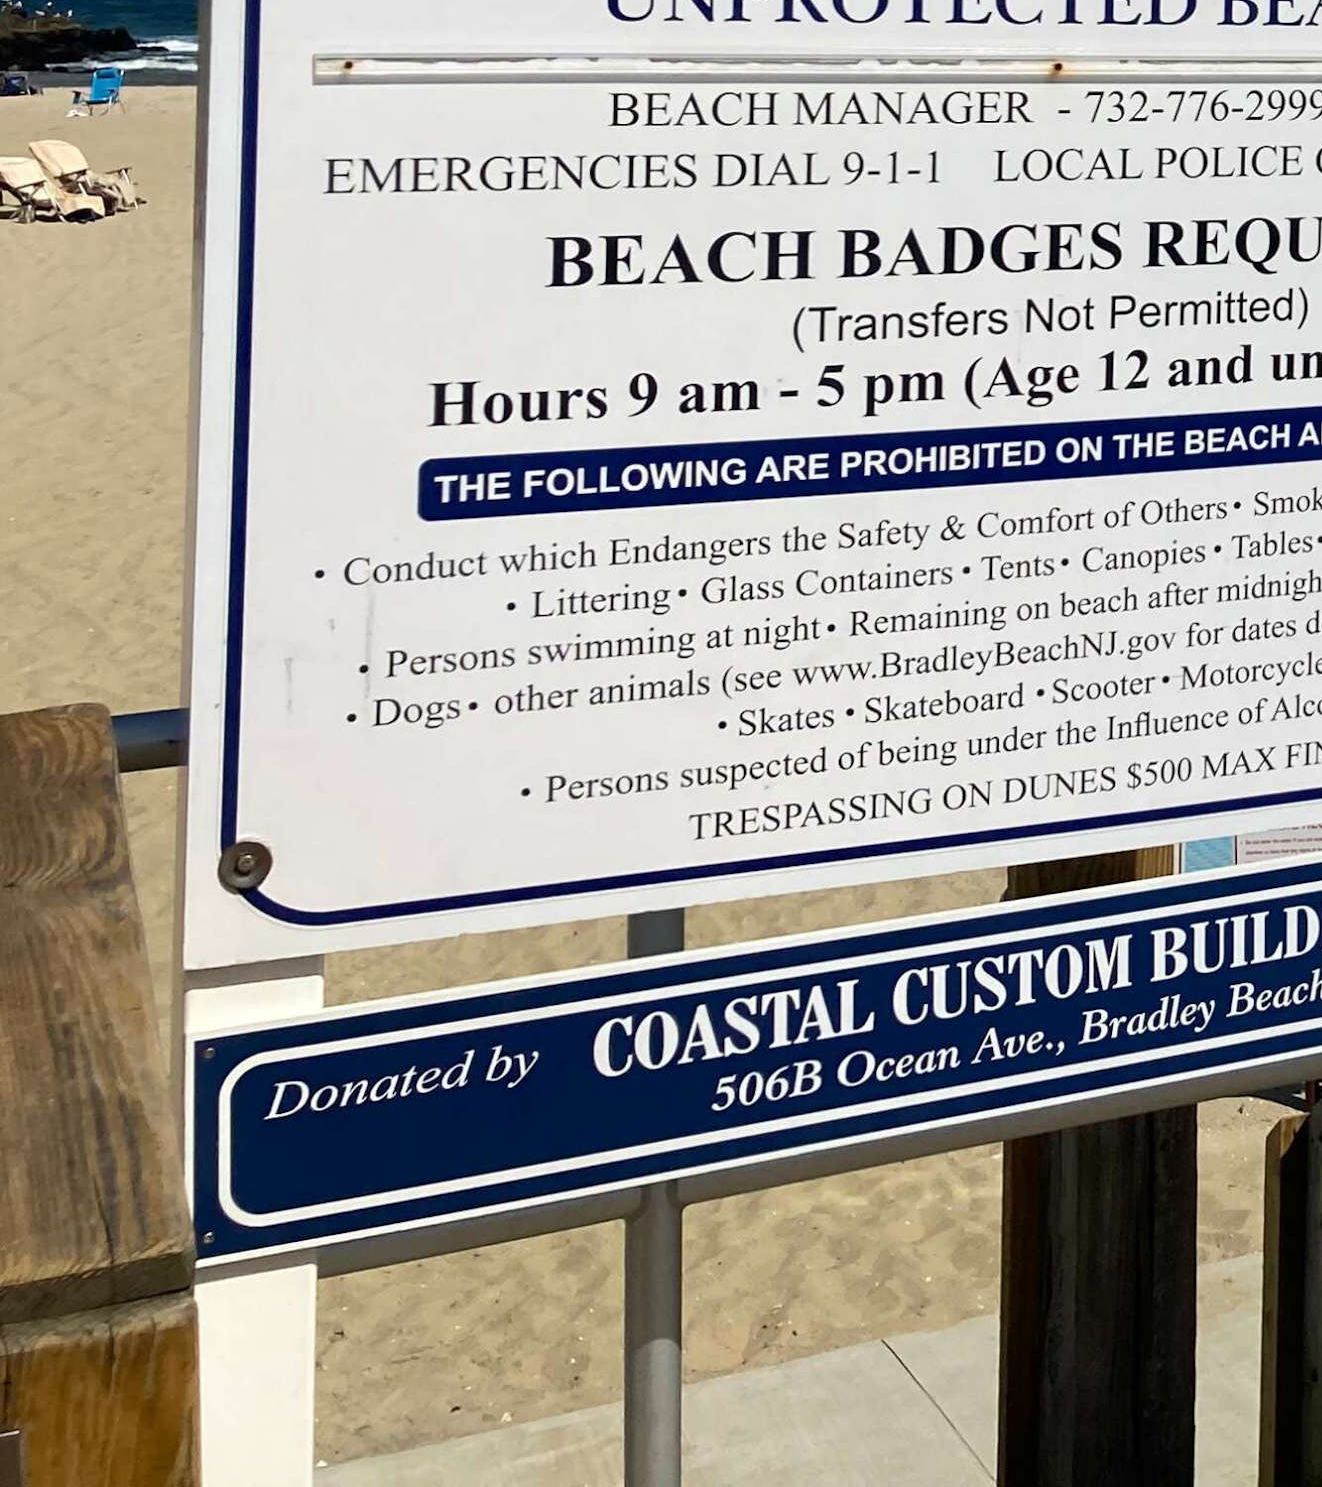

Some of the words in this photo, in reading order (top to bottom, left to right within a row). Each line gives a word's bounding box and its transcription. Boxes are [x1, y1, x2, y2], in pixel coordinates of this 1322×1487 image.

[607, 91, 780, 127] BEACH
[792, 90, 1035, 126] MANAGER
[322, 153, 698, 195] EMERGENCIES
[712, 152, 831, 188] DIAL
[842, 150, 941, 186] 9-1-1
[993, 147, 1144, 183] LOCAL
[1154, 145, 1304, 179] POLICE
[544, 230, 817, 288] BEACH
[837, 221, 1123, 279] BADGES
[792, 301, 1009, 354] (Transfers
[1025, 297, 1095, 334] Not
[1109, 286, 1309, 330] Permitted)
[427, 380, 608, 428] Hours
[628, 372, 659, 418] 9
[678, 380, 761, 414] am
[816, 364, 845, 408] 5
[863, 371, 945, 418] pm
[964, 356, 1080, 410] (Age
[1099, 349, 1150, 392] 12
[1167, 343, 1253, 388] and
[433, 471, 512, 504] THE
[523, 457, 747, 498] FOLLOWING
[755, 452, 830, 484] ARE
[840, 440, 1046, 478] PROHIBITED
[1055, 435, 1103, 464] ON
[1112, 431, 1175, 460] THE
[1184, 423, 1291, 455] BEACH
[343, 551, 488, 586] Conduct
[498, 540, 598, 574] which
[608, 534, 772, 567] Endangers
[782, 525, 827, 553] the
[837, 519, 931, 551] Safety
[939, 514, 966, 542] &
[976, 506, 1095, 539] Comfort
[1103, 500, 1136, 529] of
[1140, 497, 1228, 526] Others
[531, 582, 671, 619] Littering
[701, 575, 785, 604] Glass
[795, 562, 953, 597] Containers
[980, 554, 1056, 582] Tents
[1082, 539, 1206, 575] Canopies
[1230, 530, 1314, 560] Tables
[385, 647, 516, 679] Persons
[527, 626, 697, 666] swimming
[706, 624, 734, 650] at
[743, 614, 821, 651] night
[849, 602, 1008, 637] Remaining
[1016, 601, 1051, 622] on
[1059, 586, 1139, 618] beach
[1147, 581, 1209, 610] after
[371, 698, 461, 730] Dogs
[494, 683, 580, 715] other
[588, 668, 711, 706] animals
[721, 665, 782, 700] (see
[791, 630, 1177, 686] www.BradleyBeachNJ.gov
[1185, 621, 1225, 648] for
[1231, 616, 1297, 643] dates
[738, 707, 835, 737] Skates
[864, 681, 1025, 724] Skateboard
[1052, 675, 1157, 704] Scooter
[545, 770, 669, 804] Persons
[679, 745, 828, 791] suspected
[837, 740, 873, 771] of
[876, 735, 958, 767] being
[967, 725, 1048, 757] under
[1055, 719, 1097, 747] the
[1106, 710, 1229, 742] Influence
[1238, 698, 1268, 725] of
[688, 787, 932, 841] TRESPASSING
[942, 780, 993, 811] ON
[1003, 765, 1116, 804] DUNES
[1127, 757, 1193, 790] $500
[1202, 745, 1277, 780] MAX
[593, 979, 875, 1077] COASTAL
[892, 933, 1133, 1026] CUSTOM
[263, 1049, 476, 1120] Donated
[485, 1044, 539, 1089] by
[711, 1059, 822, 1112] 506B
[837, 1046, 961, 1087] Ocean
[970, 1027, 1065, 1065] Ave.,
[1078, 993, 1216, 1045] Bradley
